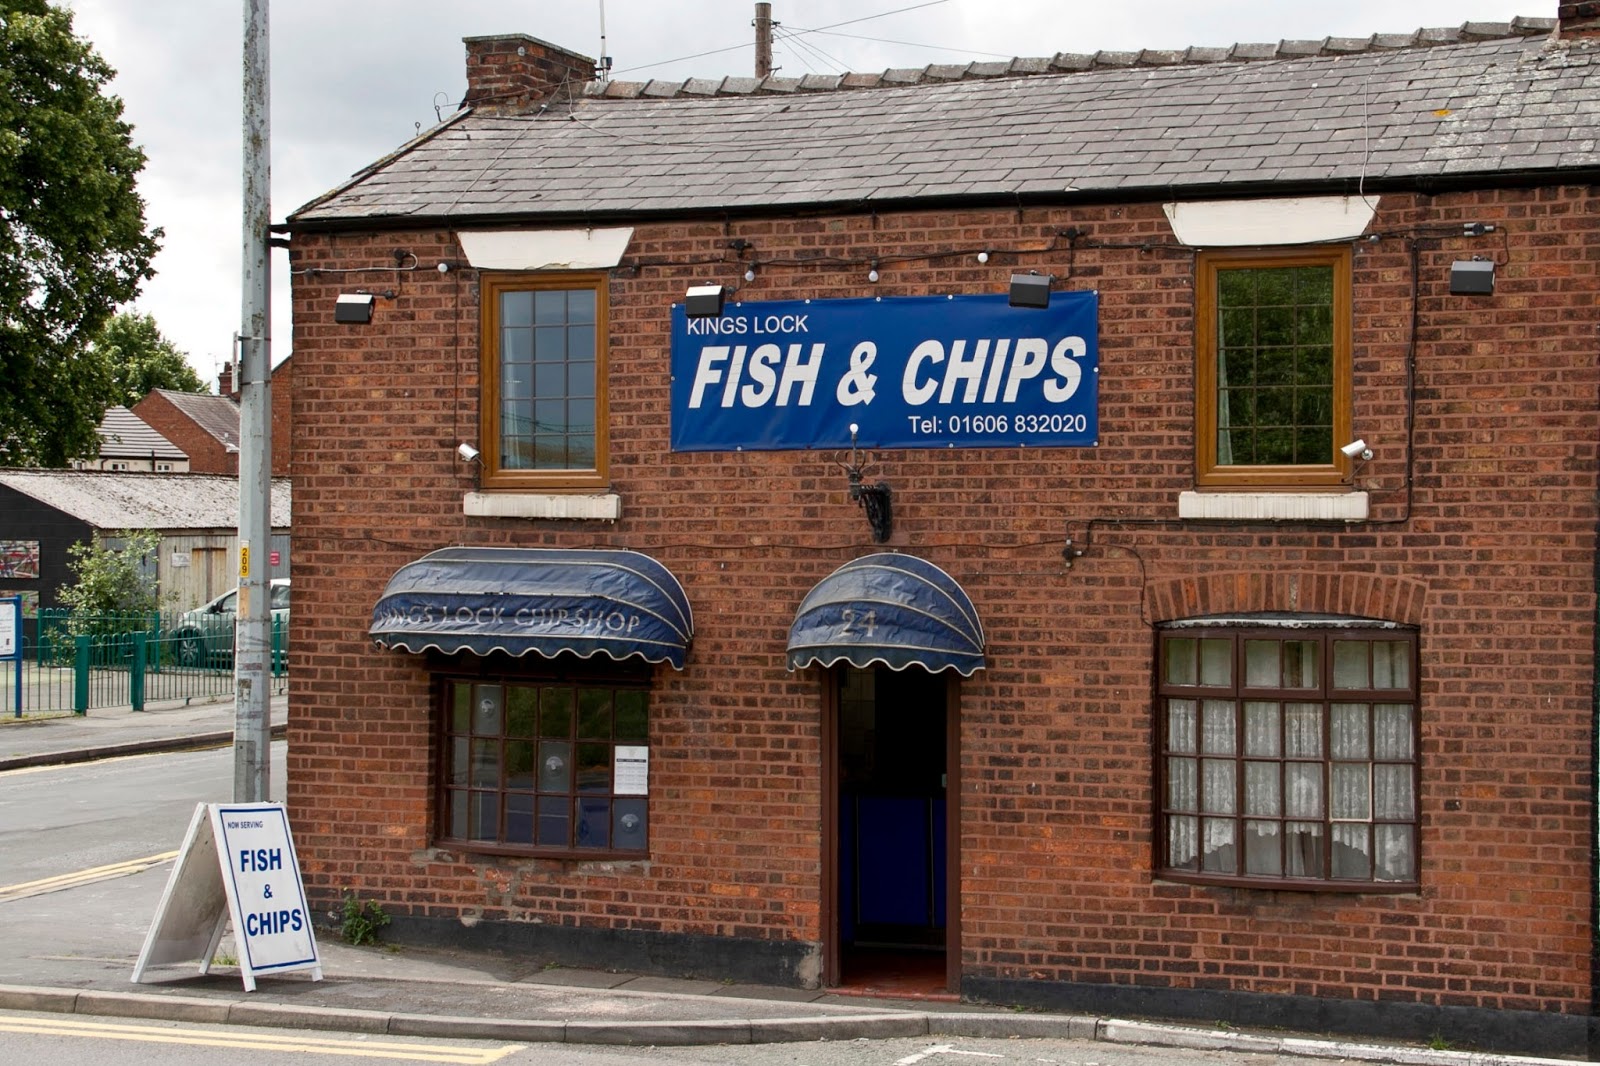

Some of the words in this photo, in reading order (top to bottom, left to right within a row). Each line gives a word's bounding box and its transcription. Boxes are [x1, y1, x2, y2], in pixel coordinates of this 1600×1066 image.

[687, 316, 748, 335] KINGS
[753, 315, 809, 334] LOCK
[688, 343, 826, 408] FISH
[836, 341, 878, 406] &
[902, 336, 1087, 406] CHIPS
[908, 415, 943, 434] Tel:
[948, 415, 1008, 434] 01606
[1014, 414, 1087, 433] 832020
[439, 606, 505, 626] LOCK
[841, 609, 879, 637] 24
[228, 821, 239, 829] NOW
[240, 820, 263, 829] SERVING
[240, 848, 282, 872] FISH
[263, 884, 273, 899] &
[247, 909, 302, 937] CHIPS
